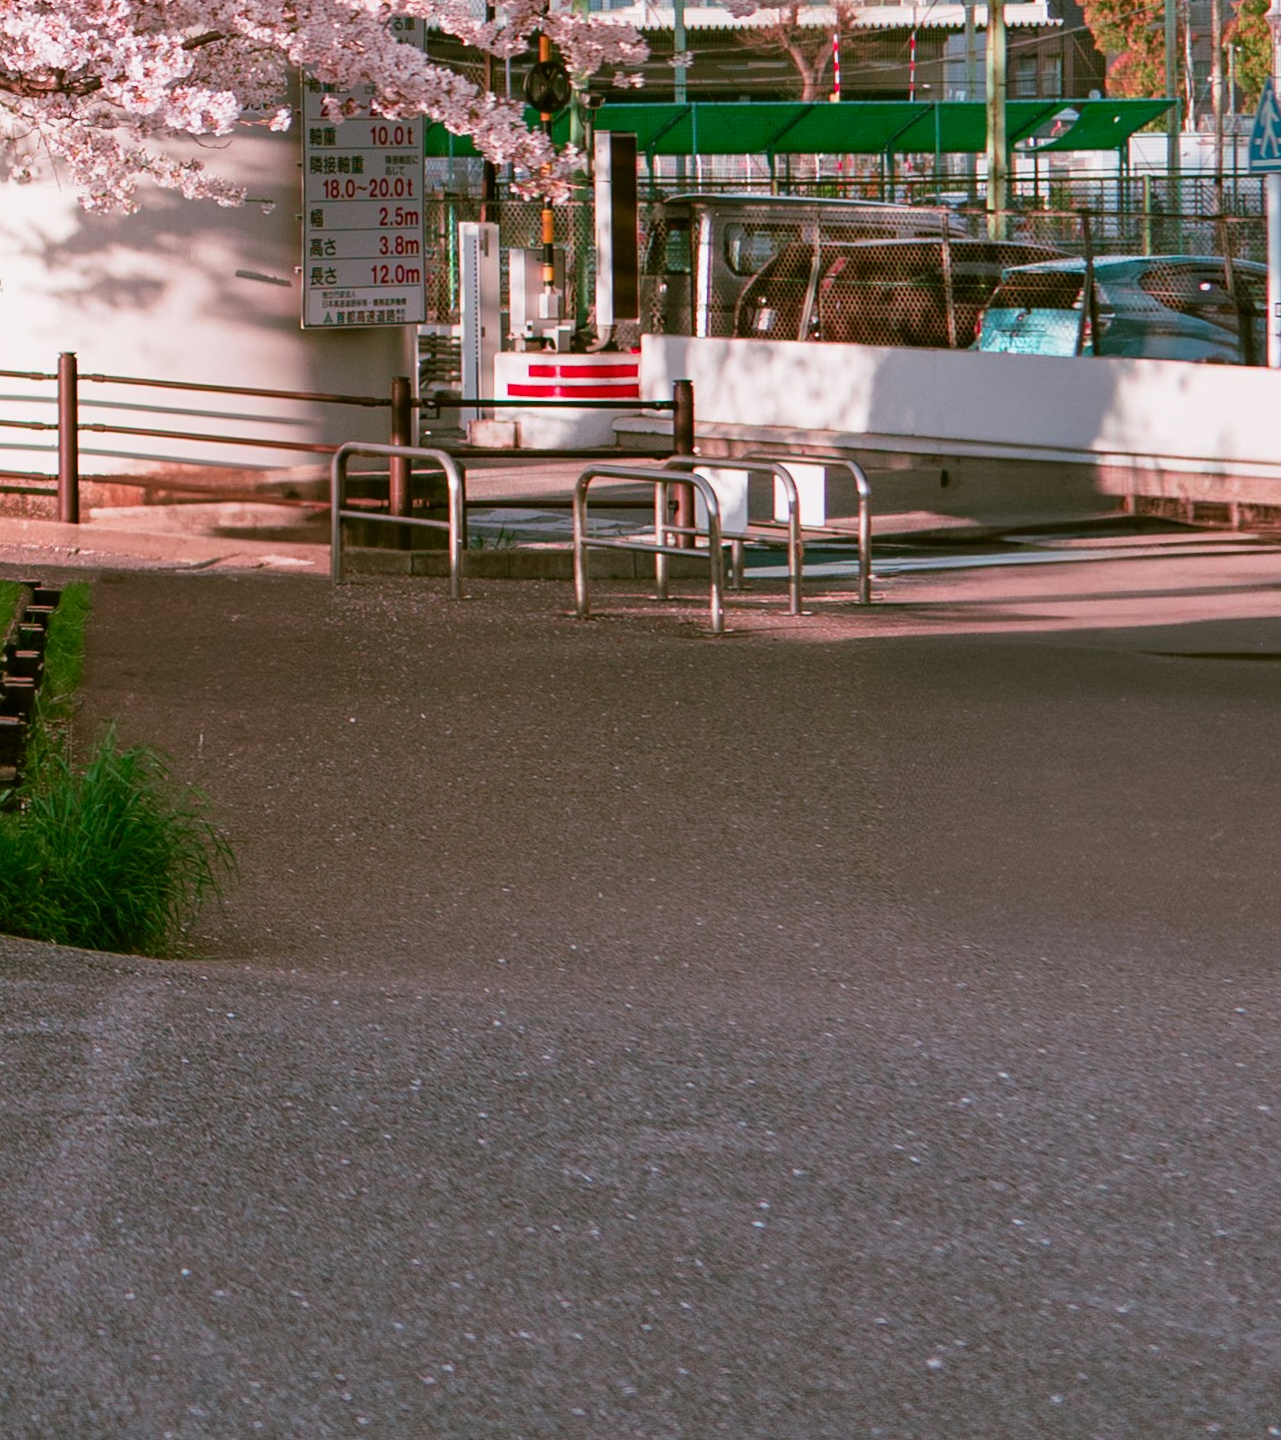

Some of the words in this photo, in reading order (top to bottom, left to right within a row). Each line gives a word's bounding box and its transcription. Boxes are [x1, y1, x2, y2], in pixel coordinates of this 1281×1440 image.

[379, 207, 419, 227] 2.5m
[310, 238, 337, 256] 高さ
[379, 236, 420, 255] 3.8m
[310, 267, 337, 286] 長さ
[371, 265, 420, 285] 12.0m
